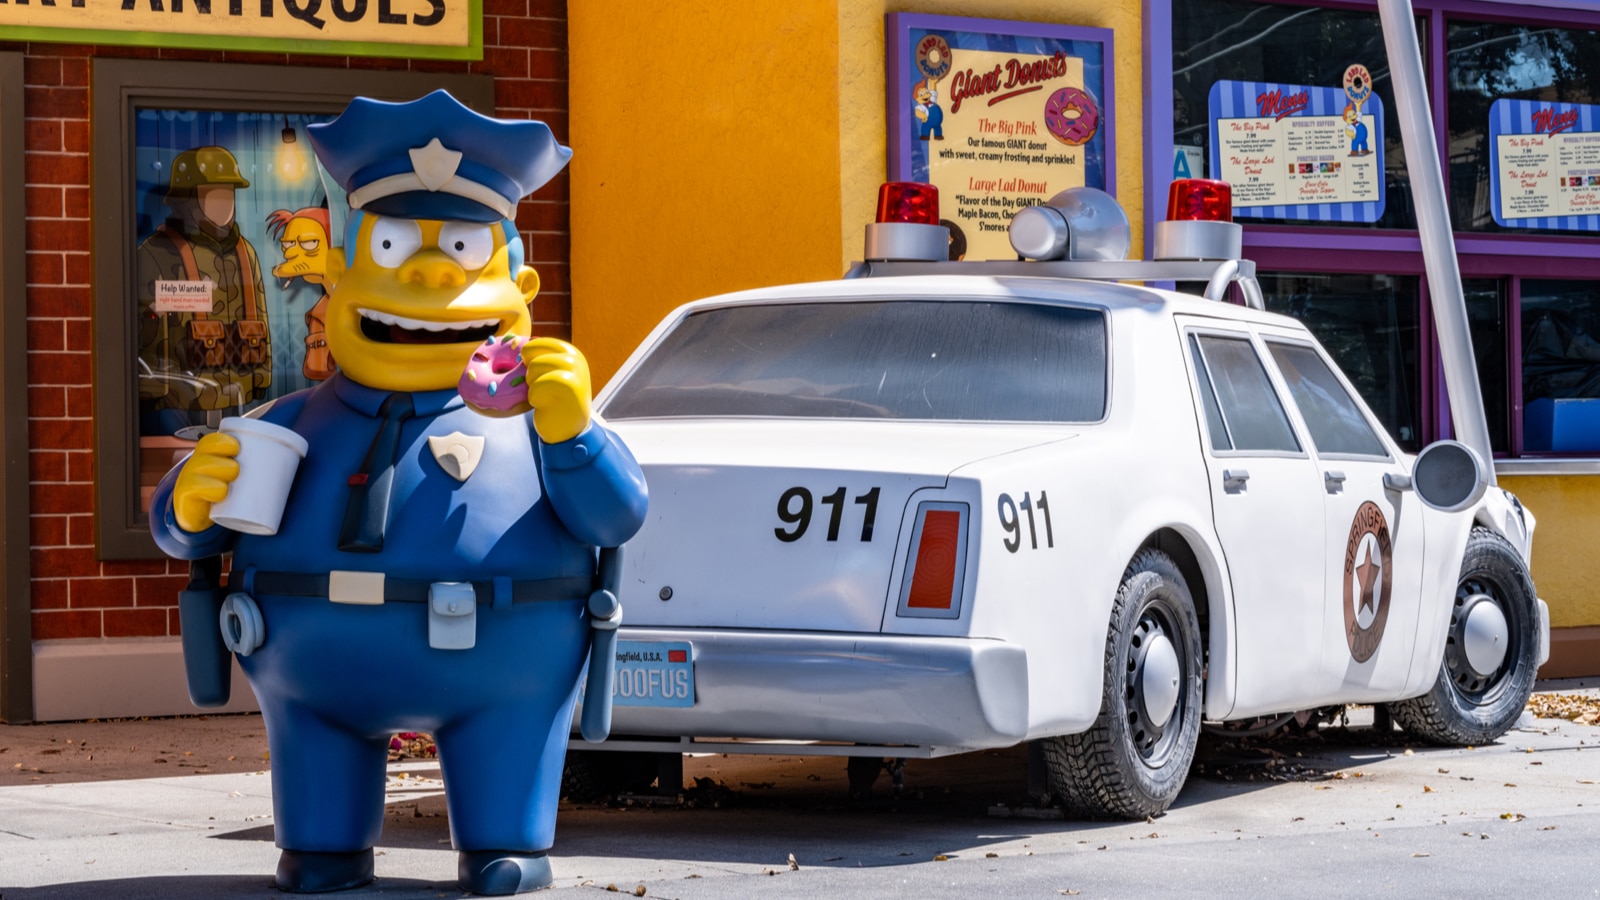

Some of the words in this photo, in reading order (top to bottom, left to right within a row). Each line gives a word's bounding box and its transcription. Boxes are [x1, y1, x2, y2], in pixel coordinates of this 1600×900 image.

[920, 38, 936, 56] LARD
[937, 39, 949, 58] LAD
[920, 59, 948, 76] DONUTS
[1346, 66, 1358, 82] LARD
[950, 64, 1002, 114] Giant
[1004, 50, 1067, 89] Donuts
[1347, 86, 1369, 100] DONUTS
[1256, 88, 1310, 117] Menu
[978, 118, 996, 132] The
[998, 120, 1014, 137] Big
[1016, 121, 1038, 136] Pink
[1230, 122, 1242, 131] The
[1244, 122, 1254, 132] Big
[1256, 122, 1270, 130] Pink
[1532, 107, 1578, 134] Menu
[968, 136, 980, 147] Our
[982, 138, 1006, 149] famous
[1006, 139, 1026, 150] GIANT
[1028, 140, 1047, 150] donut
[1509, 139, 1518, 147] The
[1520, 139, 1530, 148] Big
[1531, 138, 1544, 146] Pink
[939, 148, 954, 158] with
[956, 150, 978, 160] sweet,
[978, 152, 1004, 163] creamy
[1004, 152, 1030, 164] frosting
[1032, 154, 1044, 163] and
[1044, 155, 1076, 166] sprinkles!
[1174, 150, 1192, 179] A
[1230, 156, 1241, 165] The
[1243, 156, 1260, 166] Large
[1262, 156, 1275, 164] Lad
[1244, 166, 1262, 175] Donut
[1508, 170, 1518, 179] The
[1520, 170, 1535, 180] Large
[969, 176, 996, 195] Large
[998, 178, 1016, 192] Lad
[1018, 179, 1048, 194] Donut
[1521, 180, 1537, 188] Donut
[982, 196, 989, 205] of
[990, 196, 1002, 206] the
[1002, 196, 1015, 208] Day
[1016, 197, 1036, 208] GIANT
[958, 208, 978, 220] Maple
[979, 208, 1000, 220] Bacon,
[979, 221, 1005, 232] S'mores
[160, 283, 178, 295] Help
[179, 284, 207, 293] Wanted:
[774, 486, 881, 543] 911
[998, 490, 1054, 554] 911
[1345, 506, 1391, 578] SPRINGFIELD
[1349, 620, 1380, 656] POLICE
[615, 652, 642, 663] ingfield,
[643, 652, 663, 662] U.S.A.
